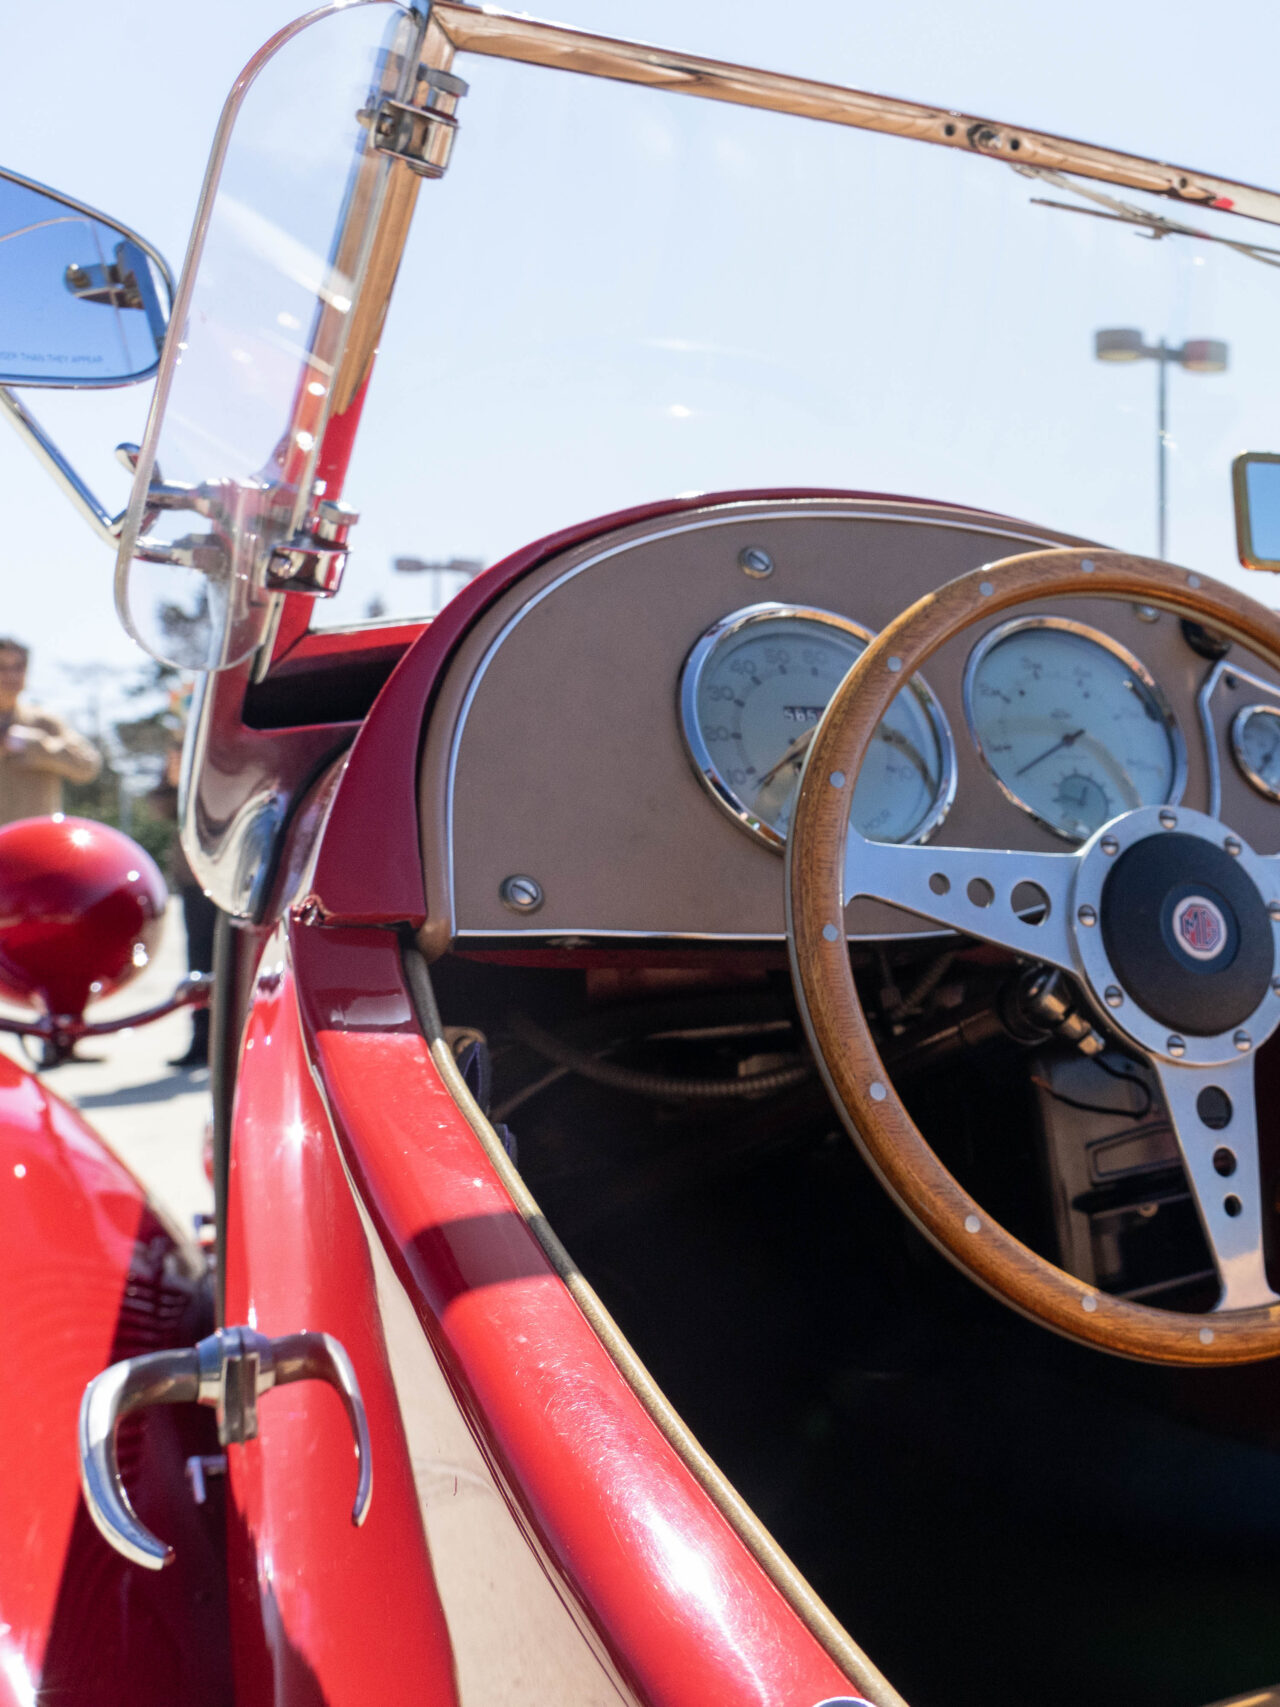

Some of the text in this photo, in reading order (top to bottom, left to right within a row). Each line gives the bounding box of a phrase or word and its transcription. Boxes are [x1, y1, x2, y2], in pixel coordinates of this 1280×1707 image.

[20, 352, 45, 362] THAN
[46, 353, 69, 363] THEY
[71, 354, 104, 363] APPEAR
[730, 659, 757, 675] 40
[706, 685, 735, 702] 30
[704, 725, 730, 742] 20
[726, 768, 747, 785] 10
[1183, 906, 1219, 949] MG
